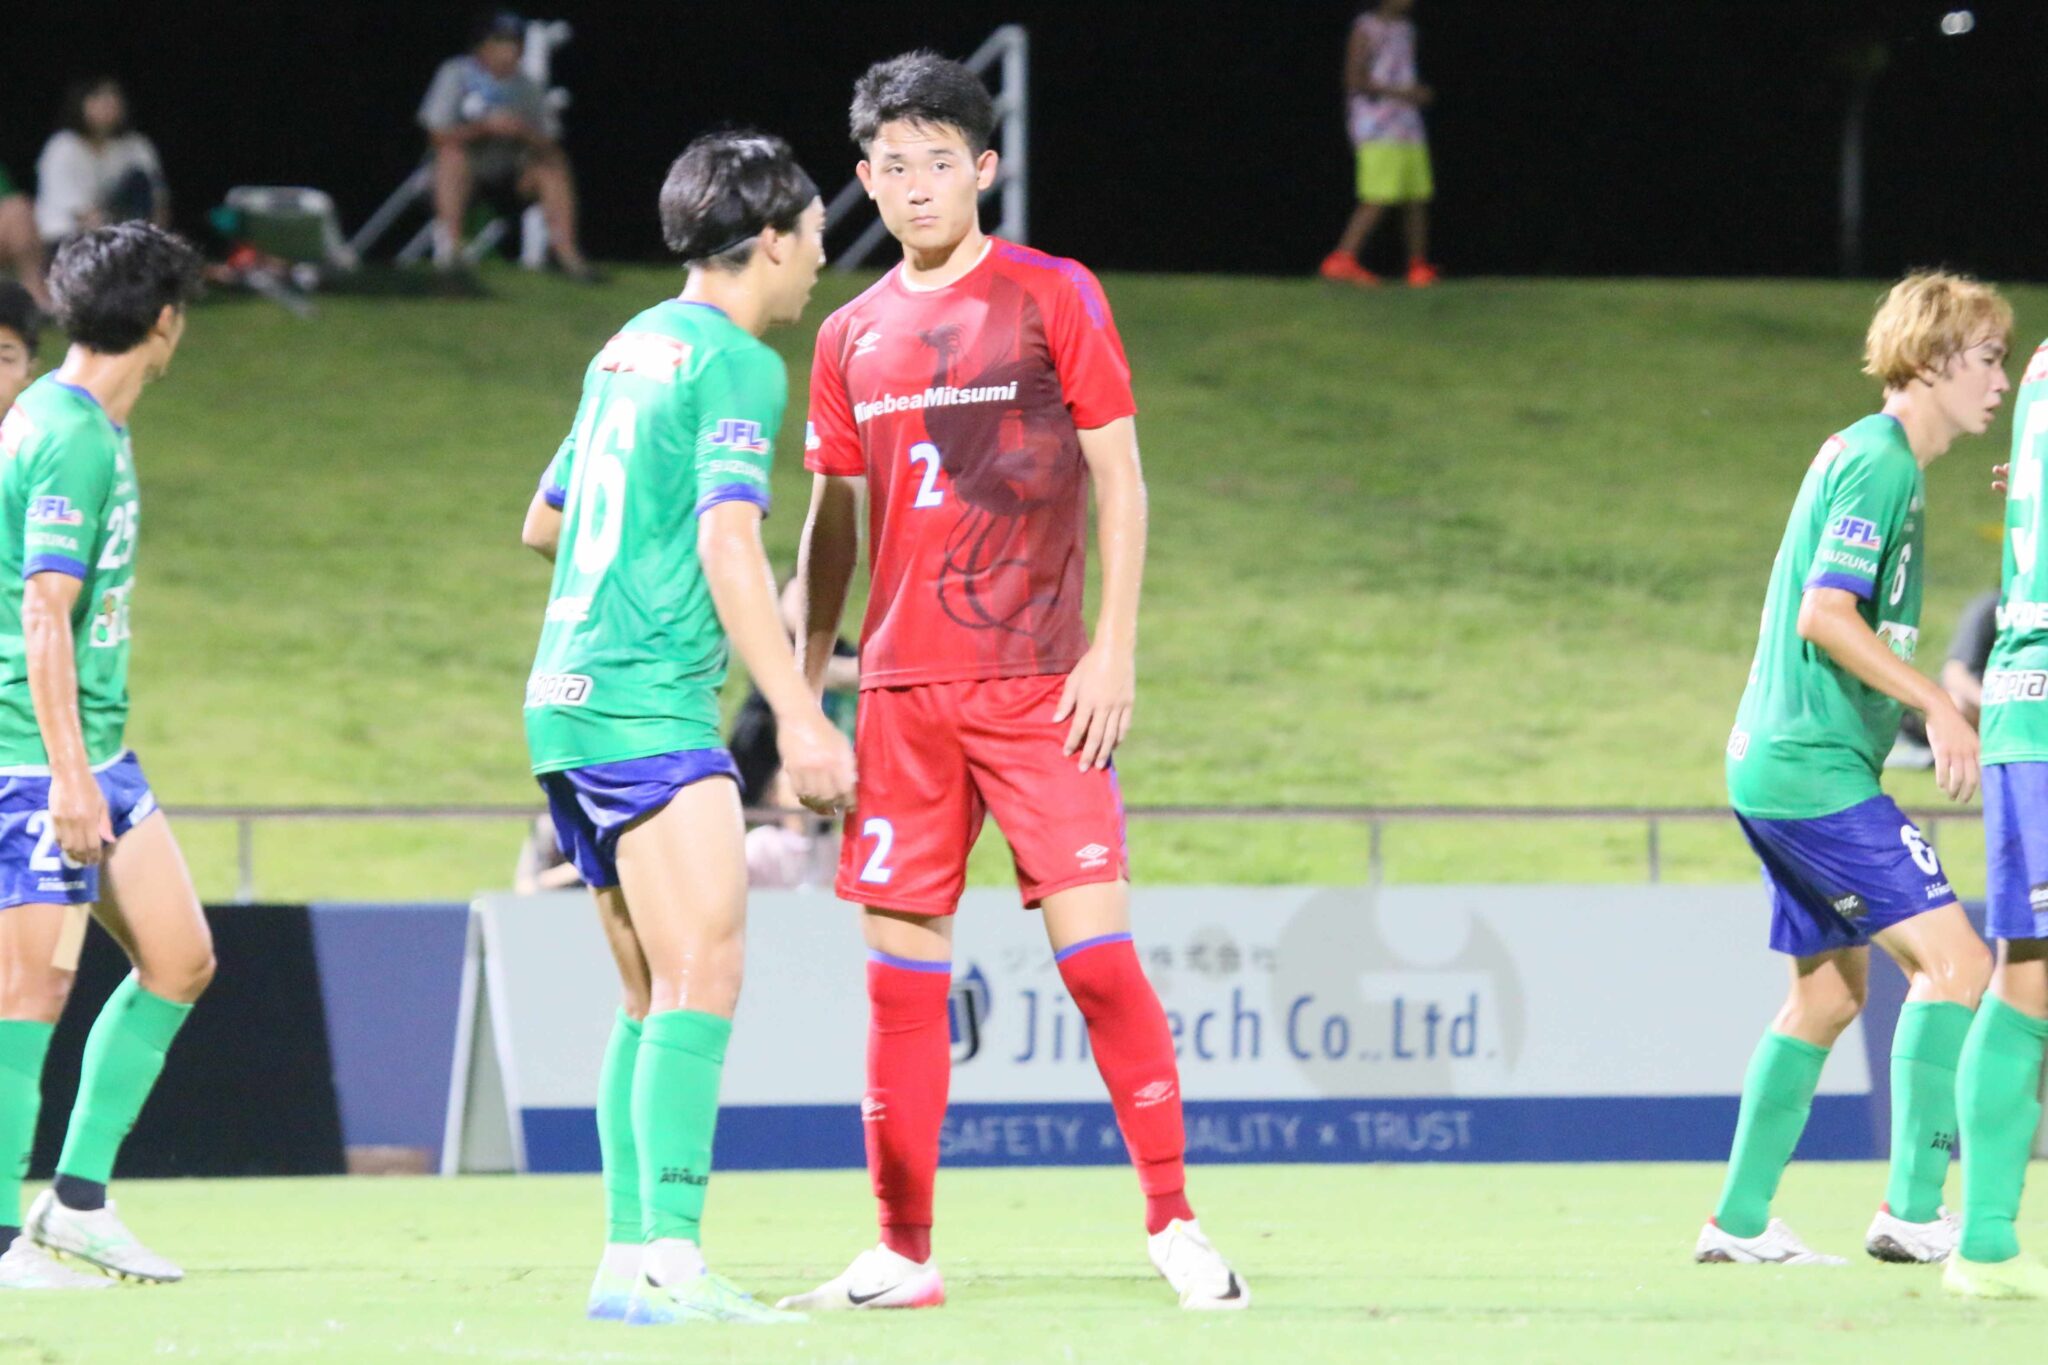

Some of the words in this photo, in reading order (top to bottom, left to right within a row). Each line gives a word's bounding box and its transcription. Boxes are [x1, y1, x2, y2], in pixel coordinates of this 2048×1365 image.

[711, 421, 763, 446] JFL
[559, 397, 637, 575] 16
[910, 441, 944, 509] 2
[28, 499, 74, 520] JFL
[96, 501, 139, 569] 25
[1832, 517, 1878, 544] JFL
[1889, 542, 1912, 606] 6
[858, 816, 895, 884] 2
[1900, 824, 1939, 876] 6
[941, 1114, 1084, 1157] SAFETY
[1180, 1111, 1302, 1154] ALITY
[1350, 1109, 1472, 1152] TRUST
